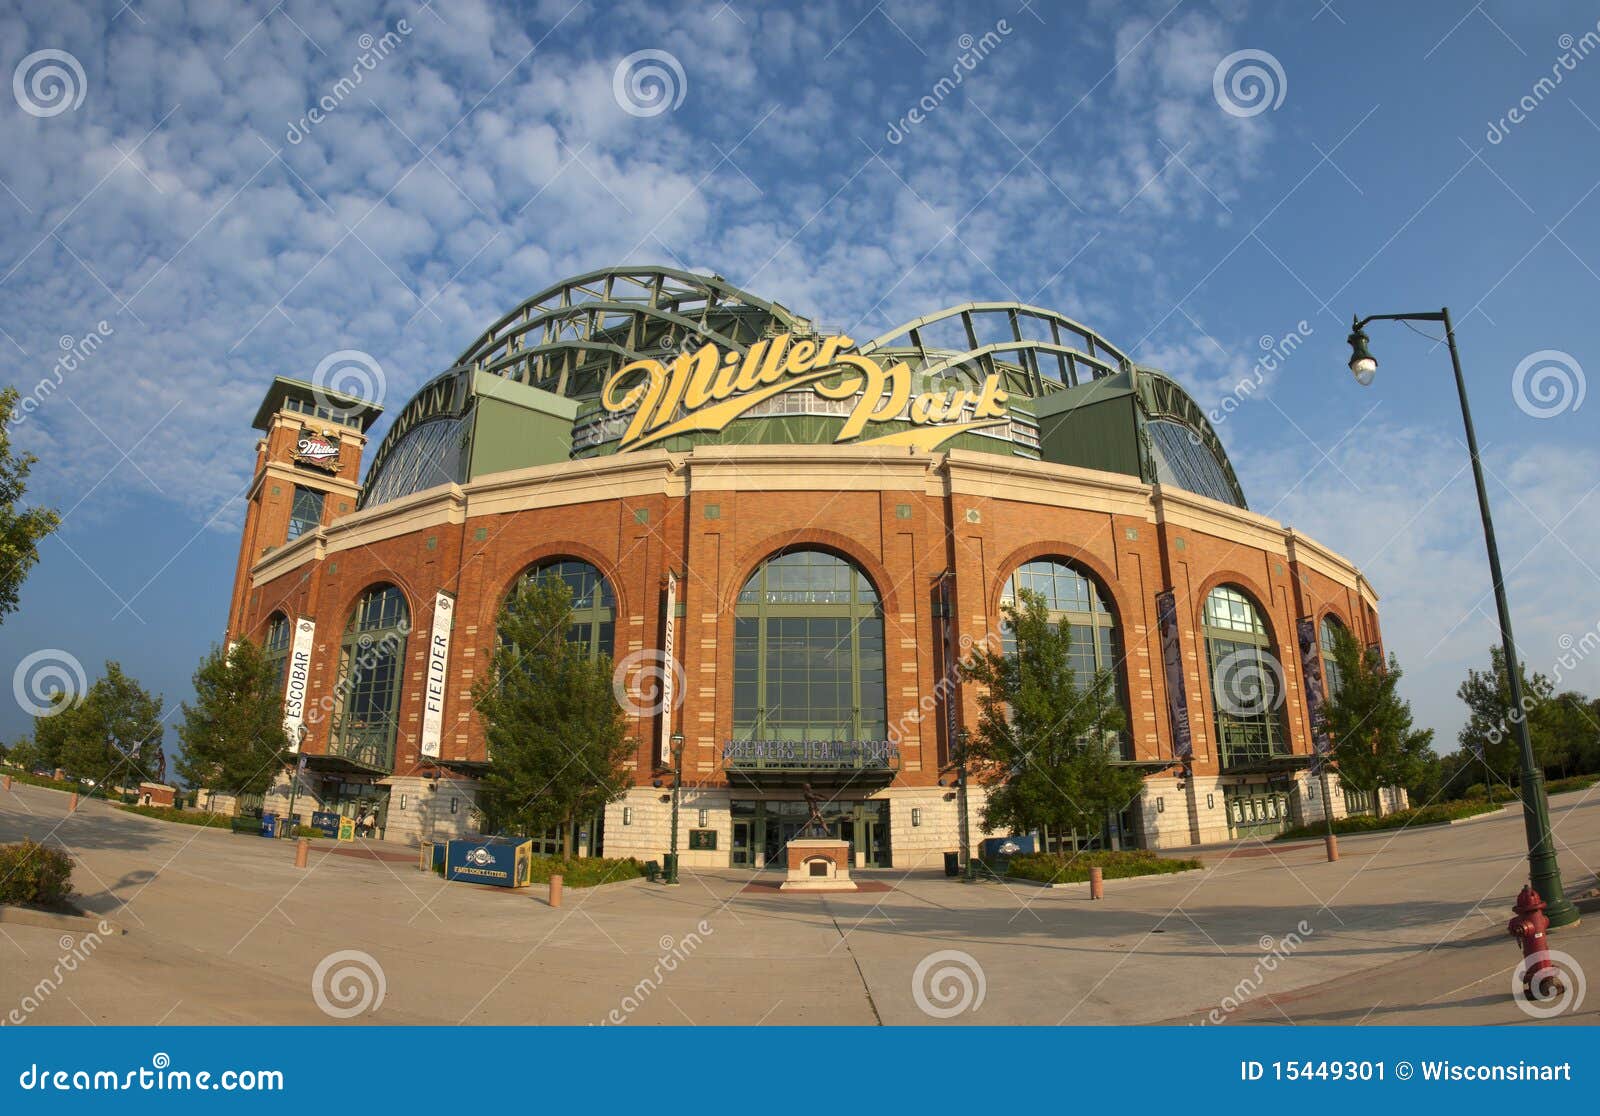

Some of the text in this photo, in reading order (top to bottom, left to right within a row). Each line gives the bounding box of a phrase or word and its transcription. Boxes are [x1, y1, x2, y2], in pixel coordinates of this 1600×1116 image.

[601, 332, 1011, 452] Miller Park
[298, 439, 340, 454] Miller
[288, 651, 309, 719] ESCOBAR
[427, 634, 447, 713] FIELDER
[664, 620, 673, 714] GALLARDO
[723, 739, 796, 760] BREWERS
[803, 739, 844, 760] TEAM
